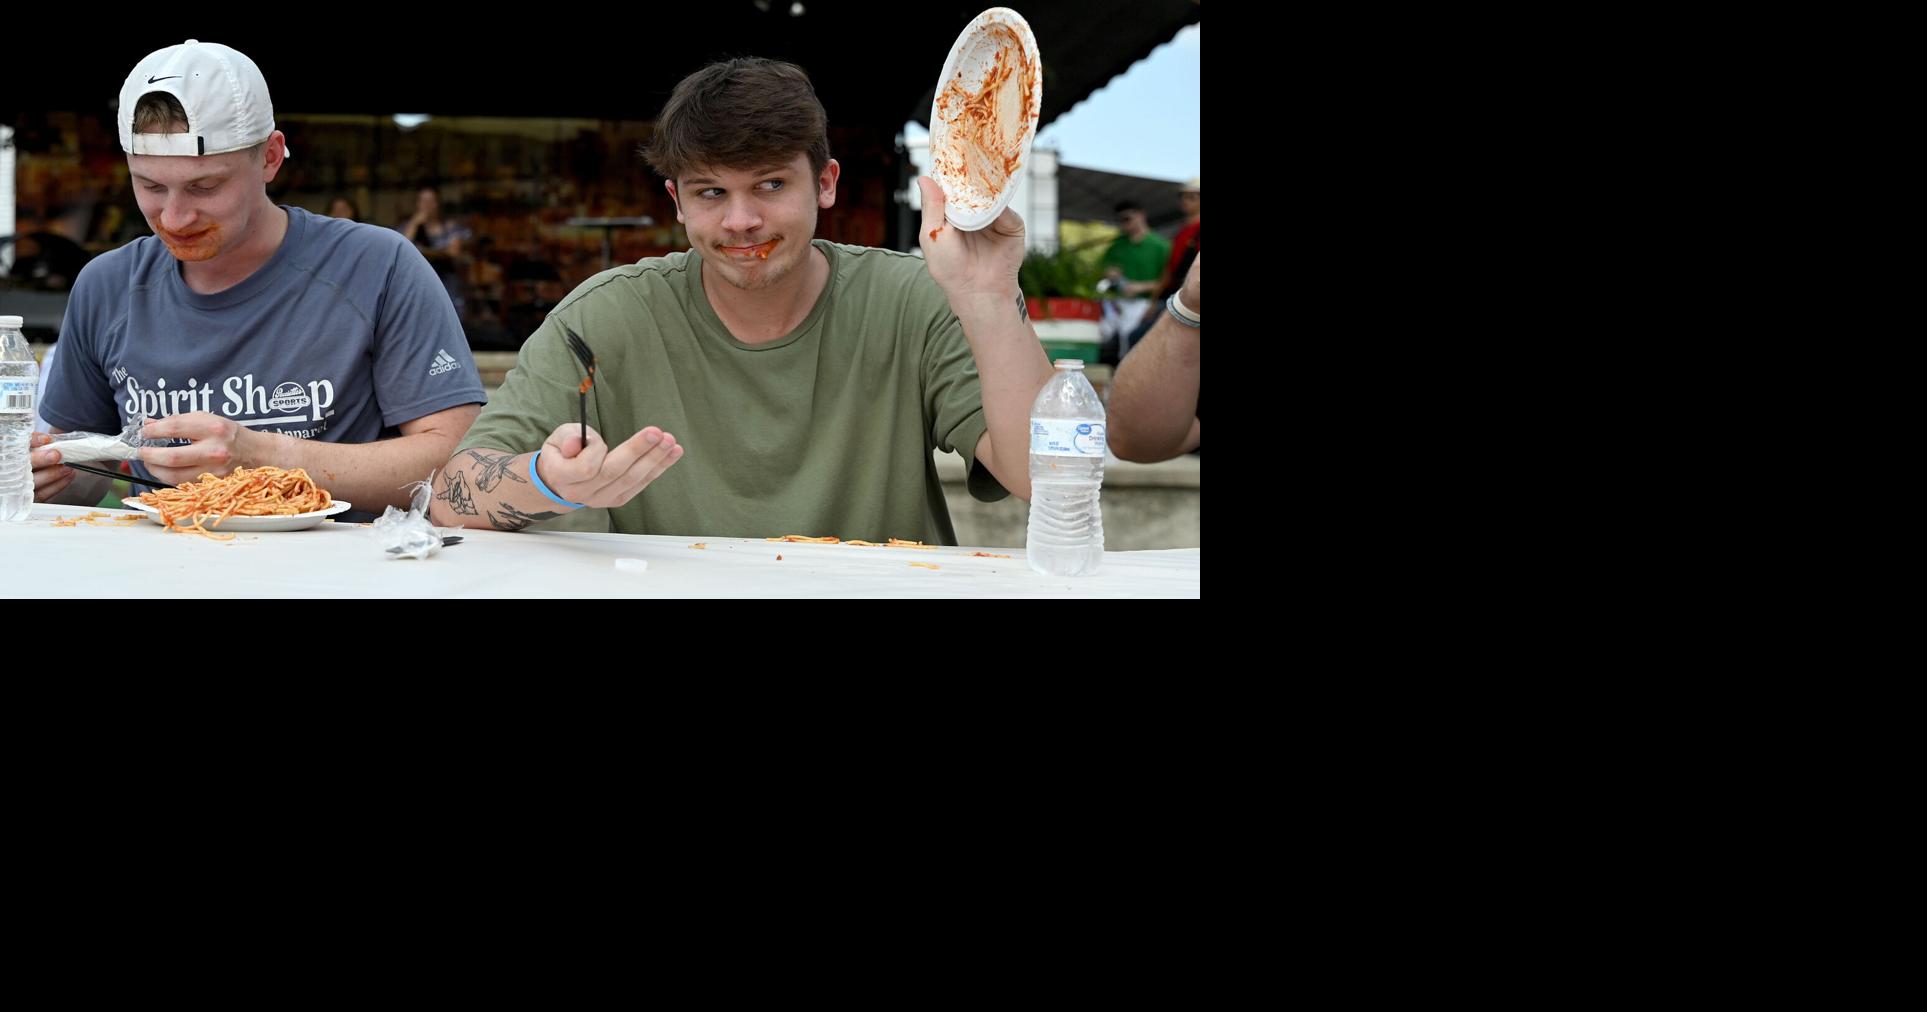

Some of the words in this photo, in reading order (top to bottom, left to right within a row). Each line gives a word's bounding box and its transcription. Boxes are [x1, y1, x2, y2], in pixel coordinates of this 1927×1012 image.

[112, 366, 128, 384] The
[125, 376, 214, 421] Spirit
[272, 397, 307, 407] SPORTS
